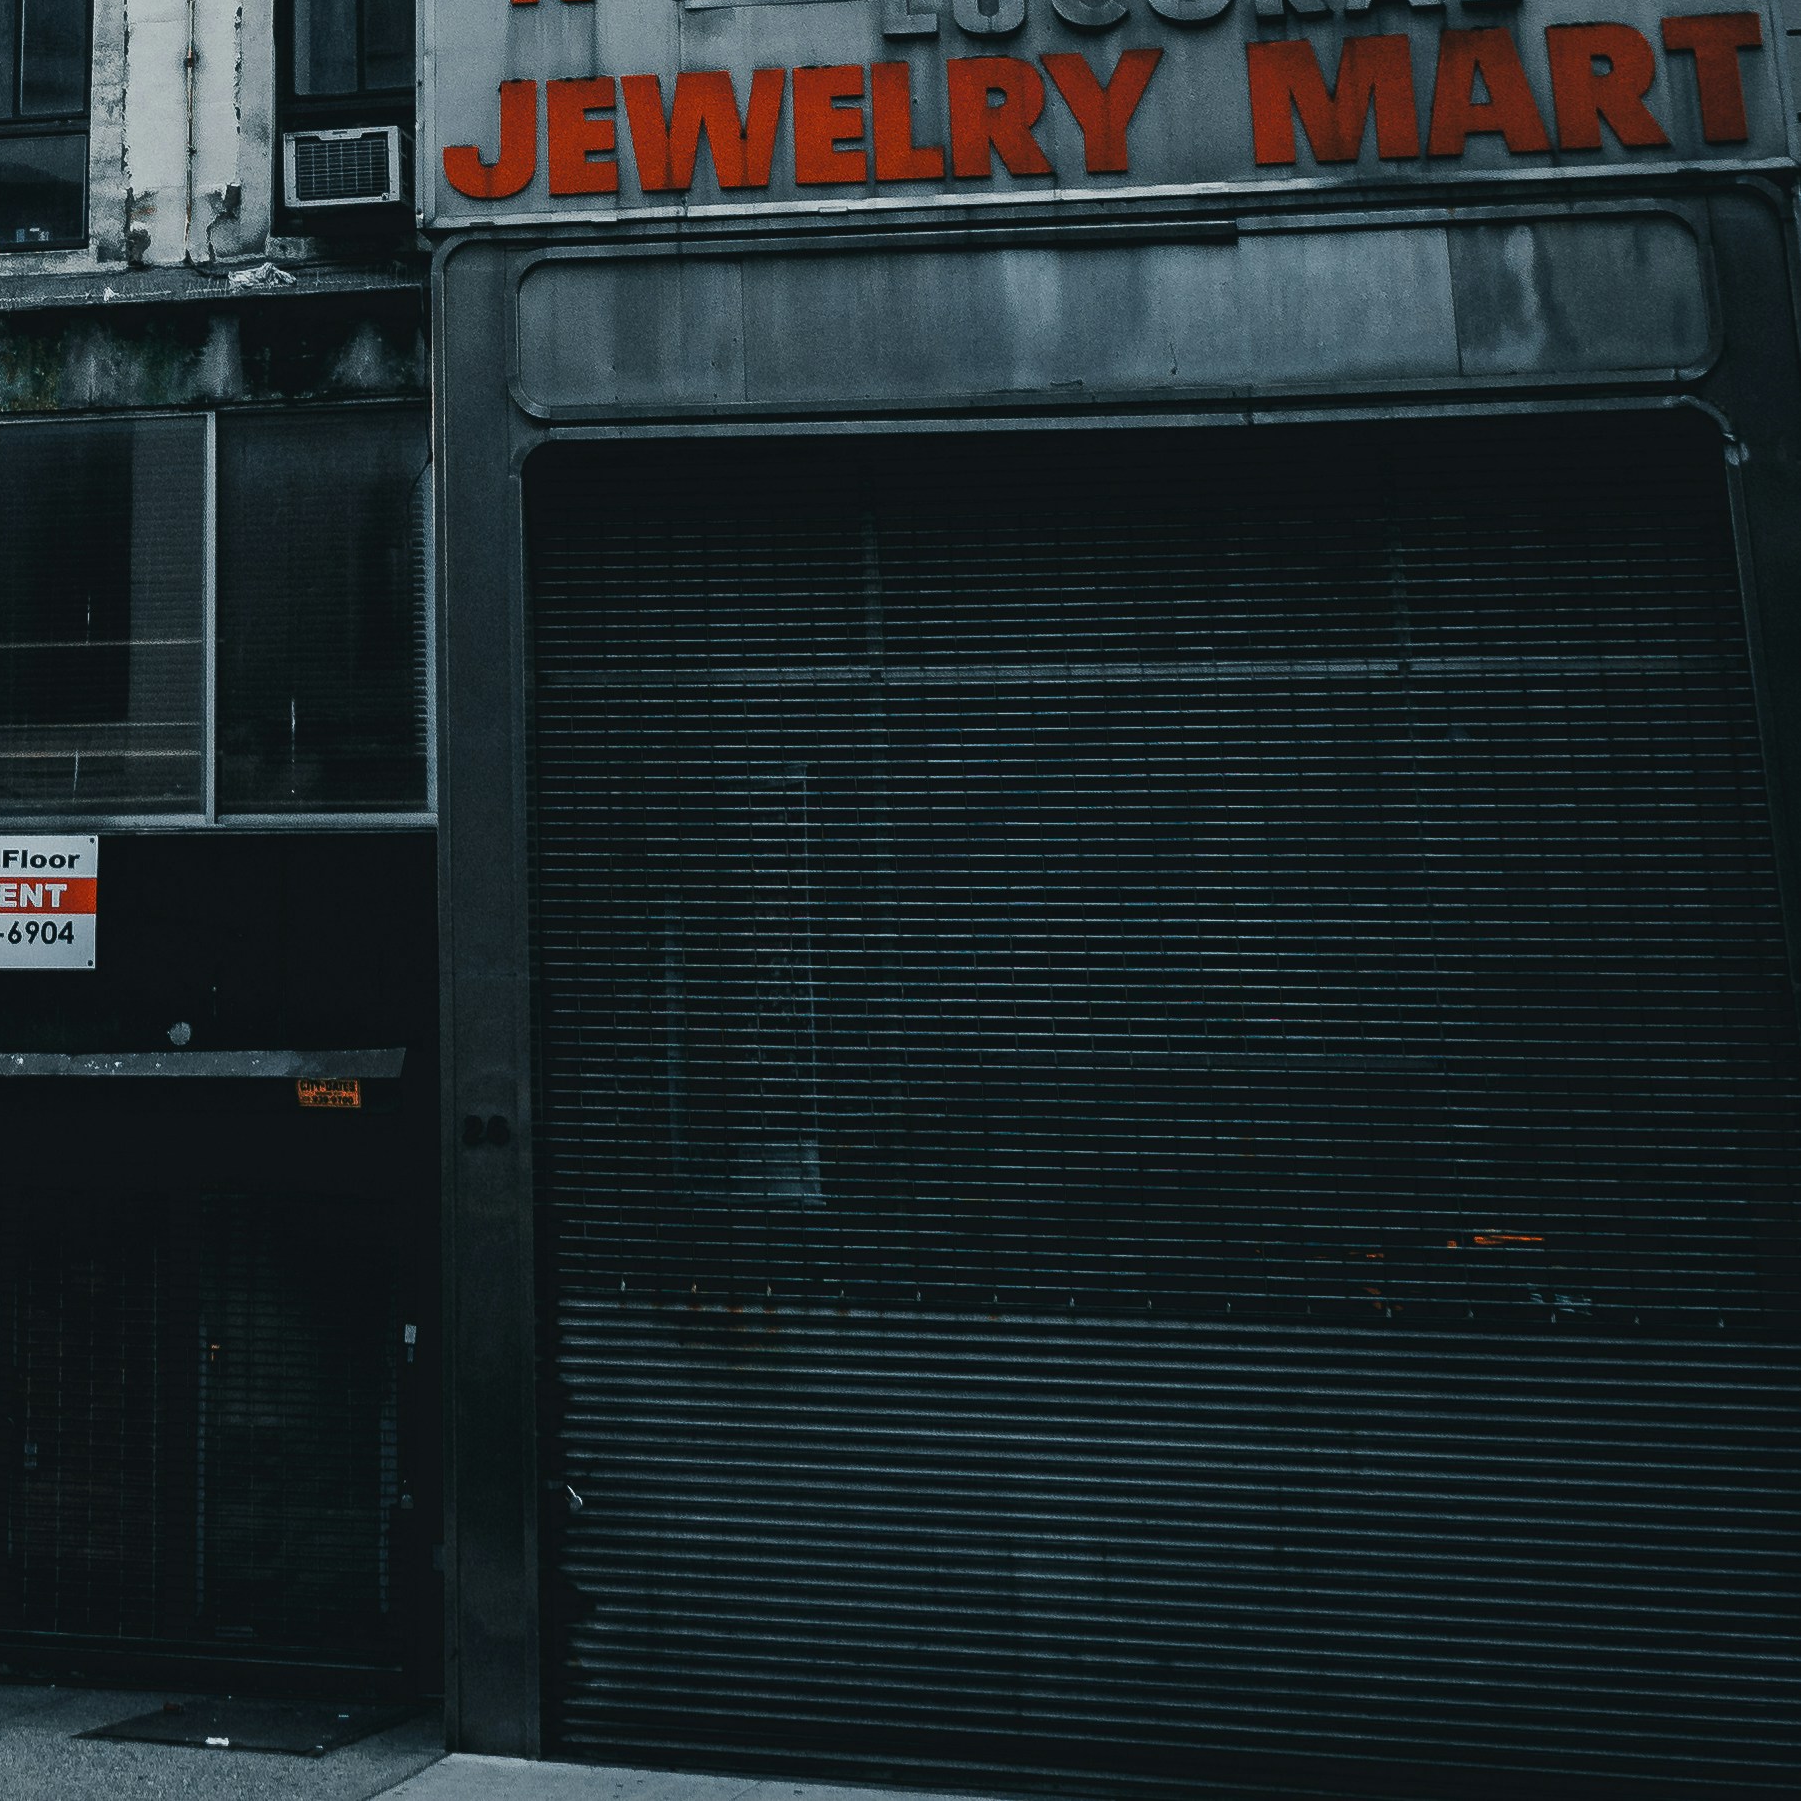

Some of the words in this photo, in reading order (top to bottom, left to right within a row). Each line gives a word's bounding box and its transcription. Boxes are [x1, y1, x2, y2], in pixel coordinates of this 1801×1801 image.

[443, 48, 1163, 198] JEWELRY
[1246, 12, 1763, 167] MART
[2, 849, 81, 869] Floor
[461, 1113, 510, 1147] 26
